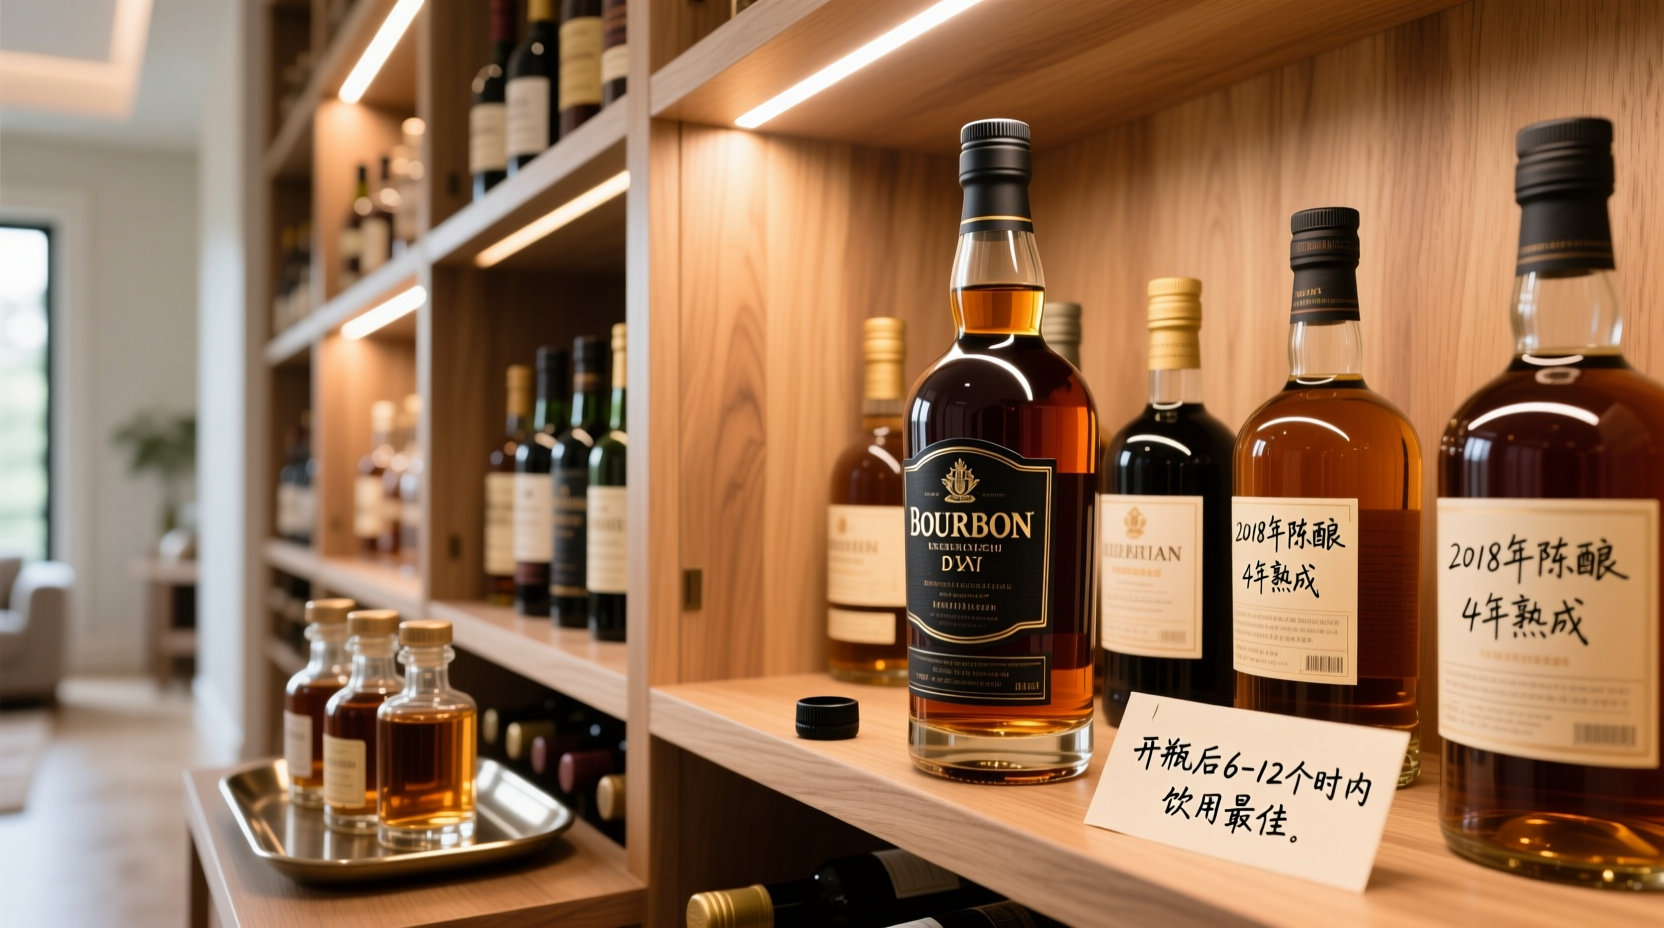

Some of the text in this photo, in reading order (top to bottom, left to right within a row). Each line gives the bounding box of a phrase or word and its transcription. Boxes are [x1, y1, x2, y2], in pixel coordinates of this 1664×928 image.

[910, 506, 1035, 539] BOURBON
[1235, 514, 1346, 553] 2018年陈酿
[1242, 559, 1320, 599] 4年熟成
[1448, 534, 1629, 584] 2018年陈酿
[1461, 592, 1589, 647] 4年熟成
[1133, 736, 1372, 807] 开瓶后6-12个时内
[1161, 785, 1298, 844] 饮用最佳。
